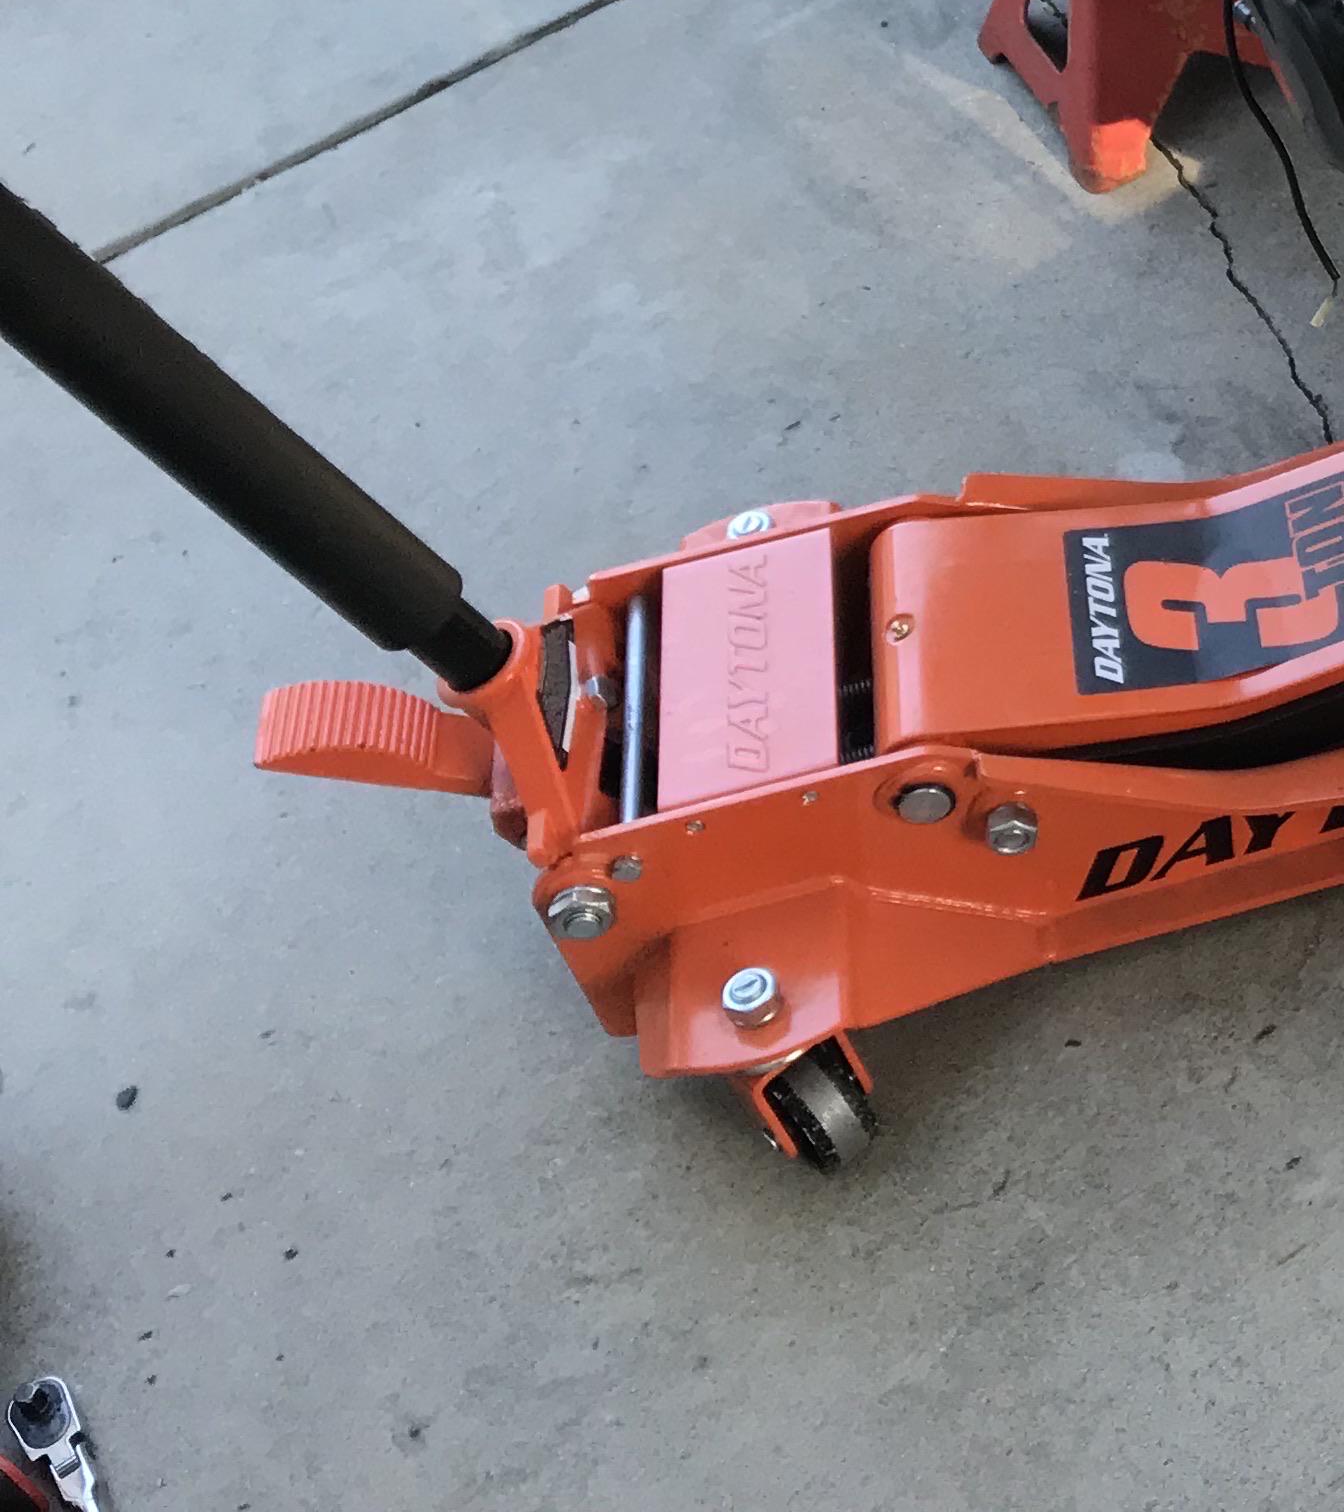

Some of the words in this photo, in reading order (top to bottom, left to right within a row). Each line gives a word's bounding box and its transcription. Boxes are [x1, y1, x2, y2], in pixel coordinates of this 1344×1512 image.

[726, 554, 771, 773] DAYTONA
[1081, 535, 1126, 684] DAYTONA
[1123, 556, 1339, 652] 3
